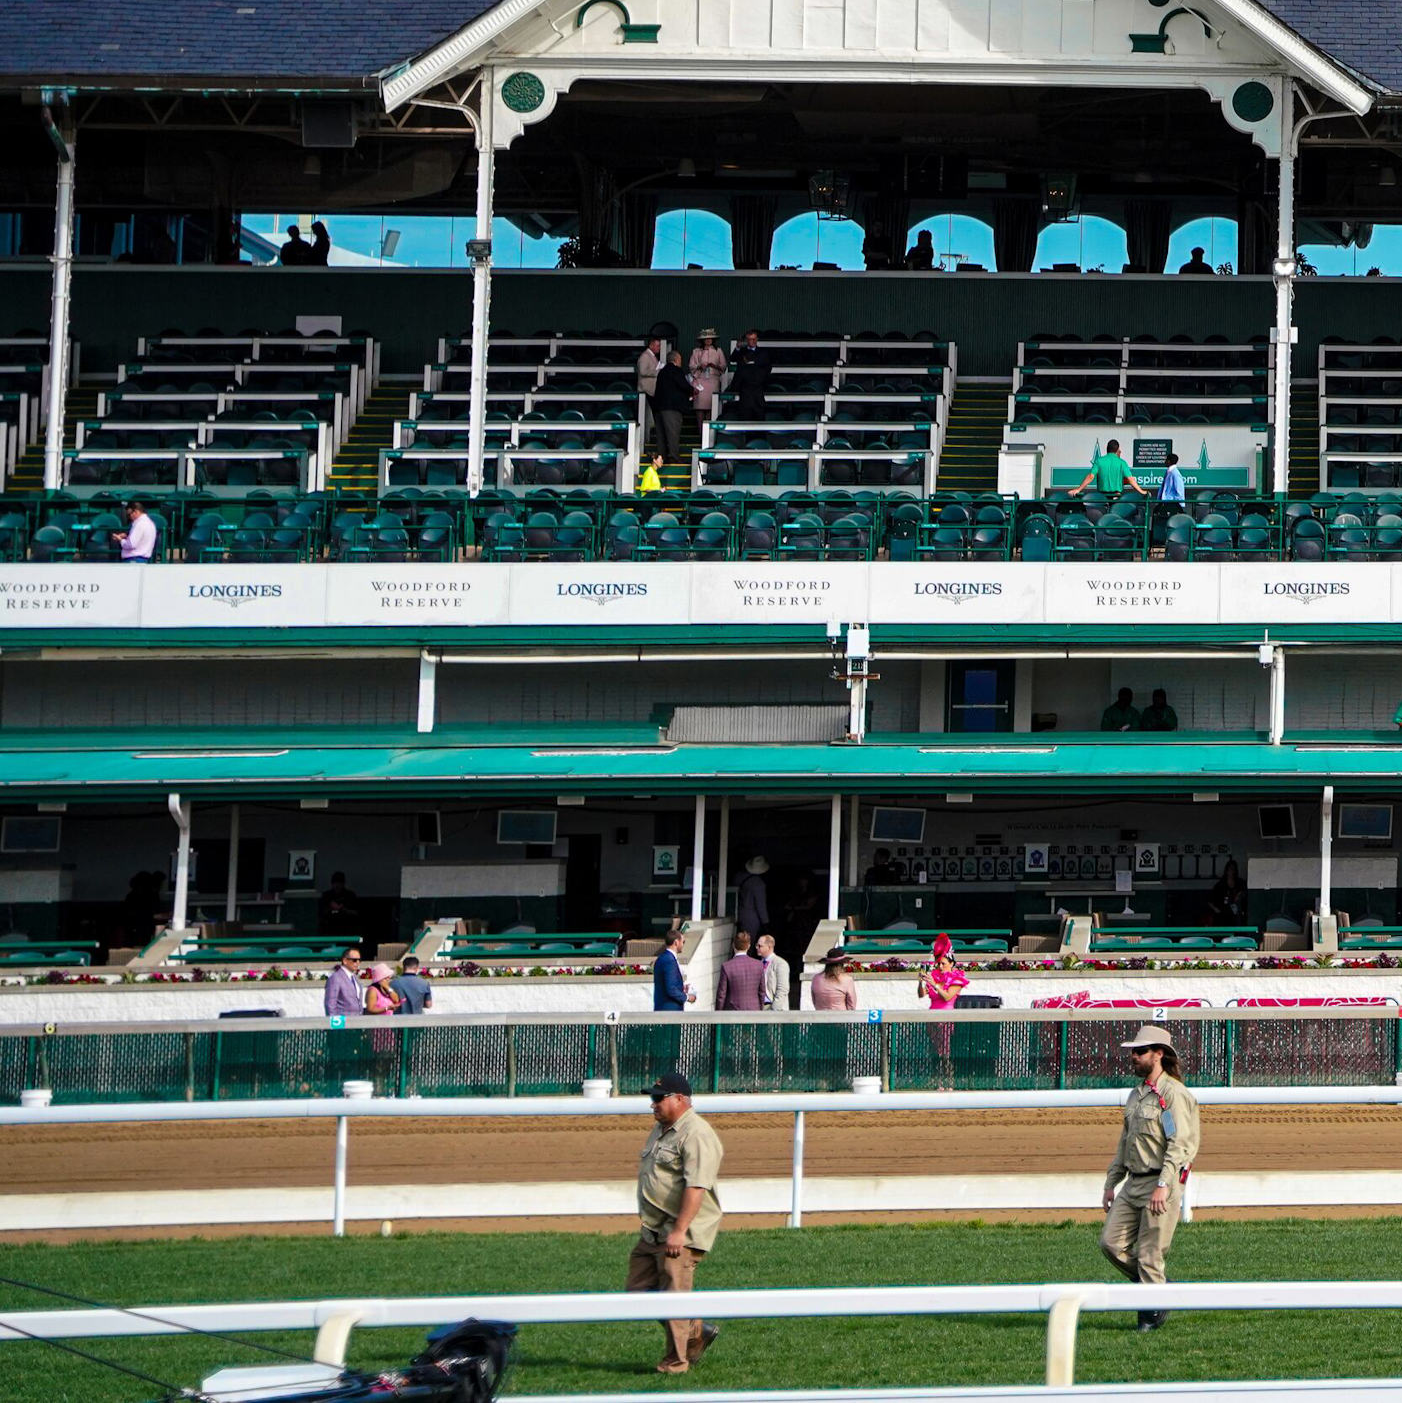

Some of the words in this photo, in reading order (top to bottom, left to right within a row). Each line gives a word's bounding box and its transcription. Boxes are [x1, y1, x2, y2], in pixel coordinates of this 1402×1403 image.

[188, 584, 282, 597] LONGINES
[371, 581, 471, 592] WOODFORD
[556, 583, 648, 596] LONGINES
[733, 580, 831, 591] WOODFORD
[914, 582, 1002, 595] LONGINES
[1086, 580, 1182, 591] WOODFORD
[1263, 582, 1350, 595] LONGINES
[6, 598, 90, 609] RESERVE
[381, 597, 462, 607] RESERVE
[743, 596, 822, 606] RESERVE
[1096, 596, 1173, 606] RESERVE
[607, 1011, 616, 1021] 4
[870, 1009, 880, 1020] 3
[1155, 1009, 1164, 1018] 2
[332, 1015, 342, 1026] 5
